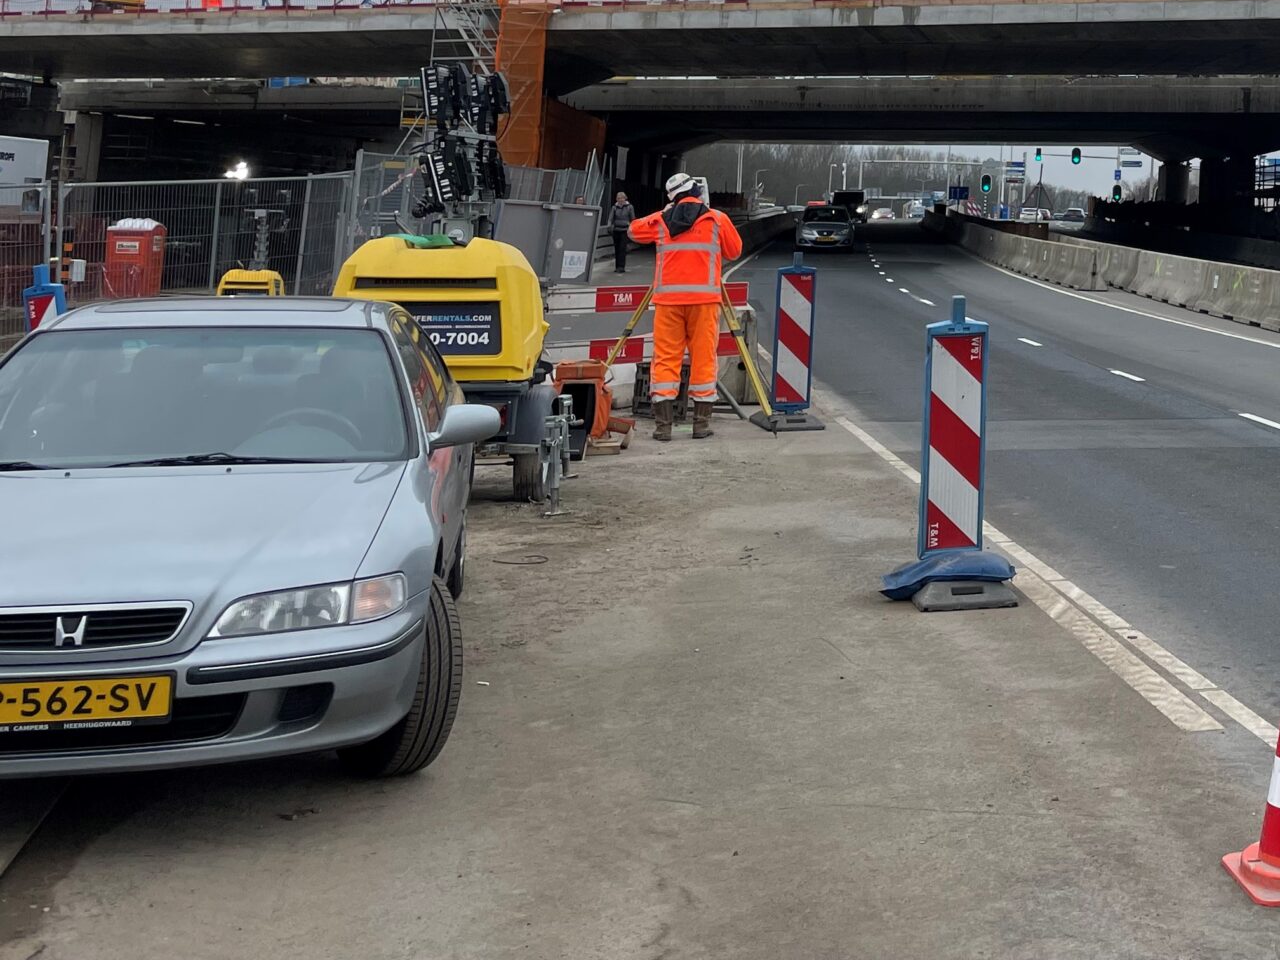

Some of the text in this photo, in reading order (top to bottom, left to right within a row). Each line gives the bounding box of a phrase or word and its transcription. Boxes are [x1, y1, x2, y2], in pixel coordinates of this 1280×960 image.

[612, 293, 633, 303] T&M
[971, 336, 980, 361] T&M
[930, 522, 939, 548] T&M
[0, 682, 157, 717] -562-SV
[13, 724, 49, 732] CAMPERS
[63, 720, 132, 730] HEERHUGOWAARD
